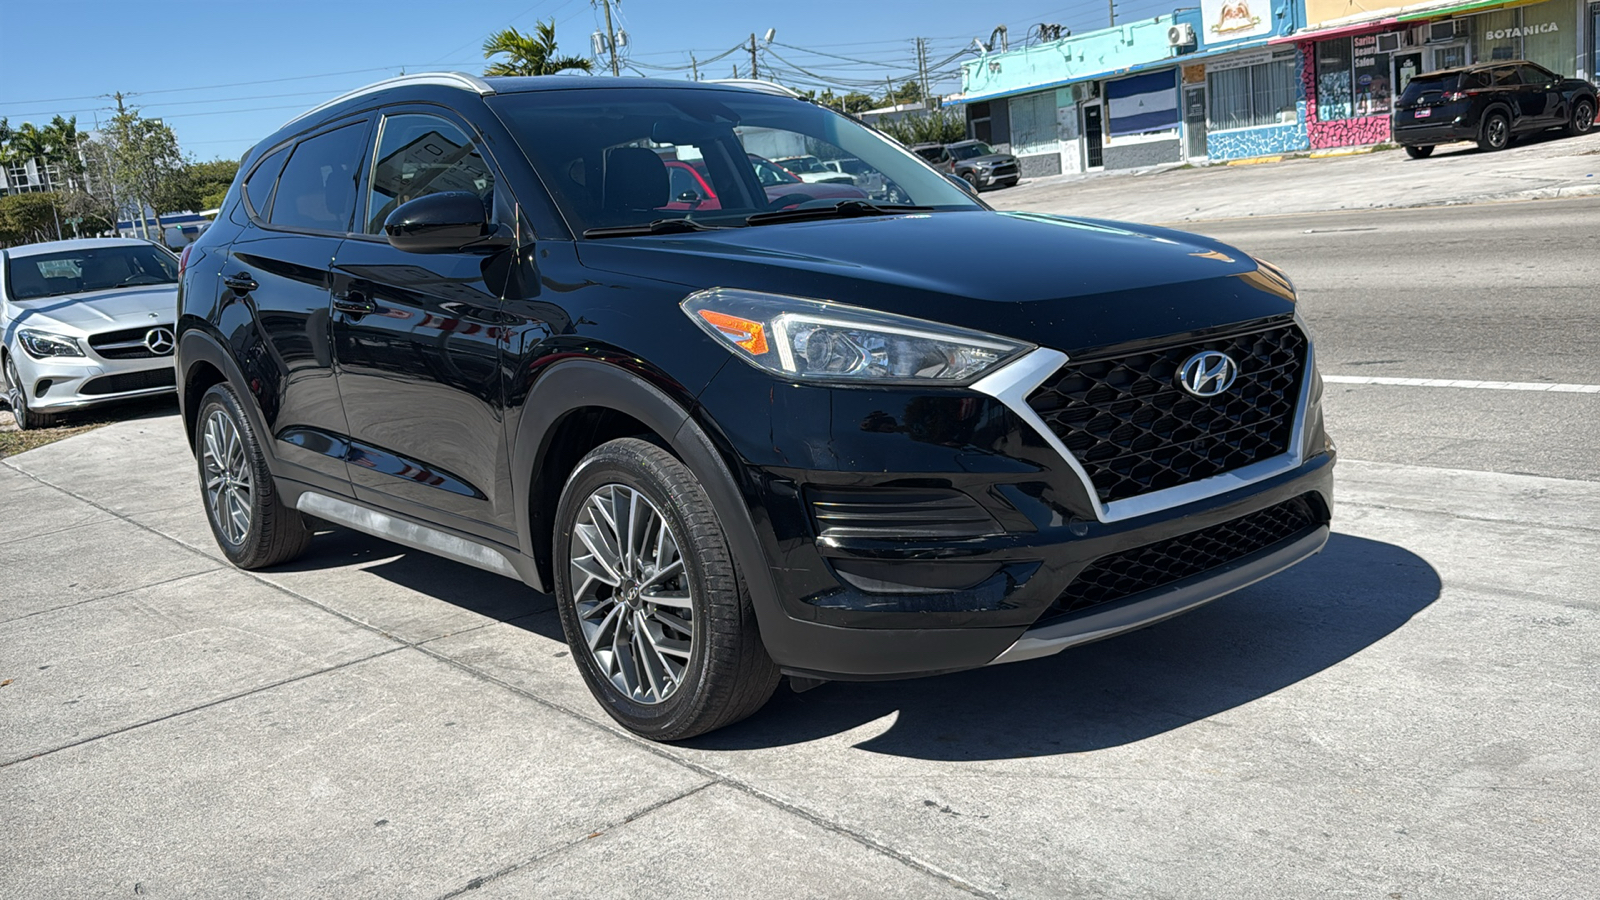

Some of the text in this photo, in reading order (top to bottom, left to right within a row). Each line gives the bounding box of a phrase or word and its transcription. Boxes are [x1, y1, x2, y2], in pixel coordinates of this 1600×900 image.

[1485, 22, 1559, 40] BOTANICA
[1354, 36, 1375, 47] Sarita
[1354, 47, 1377, 57] Beauty
[1355, 57, 1375, 68] Salon
